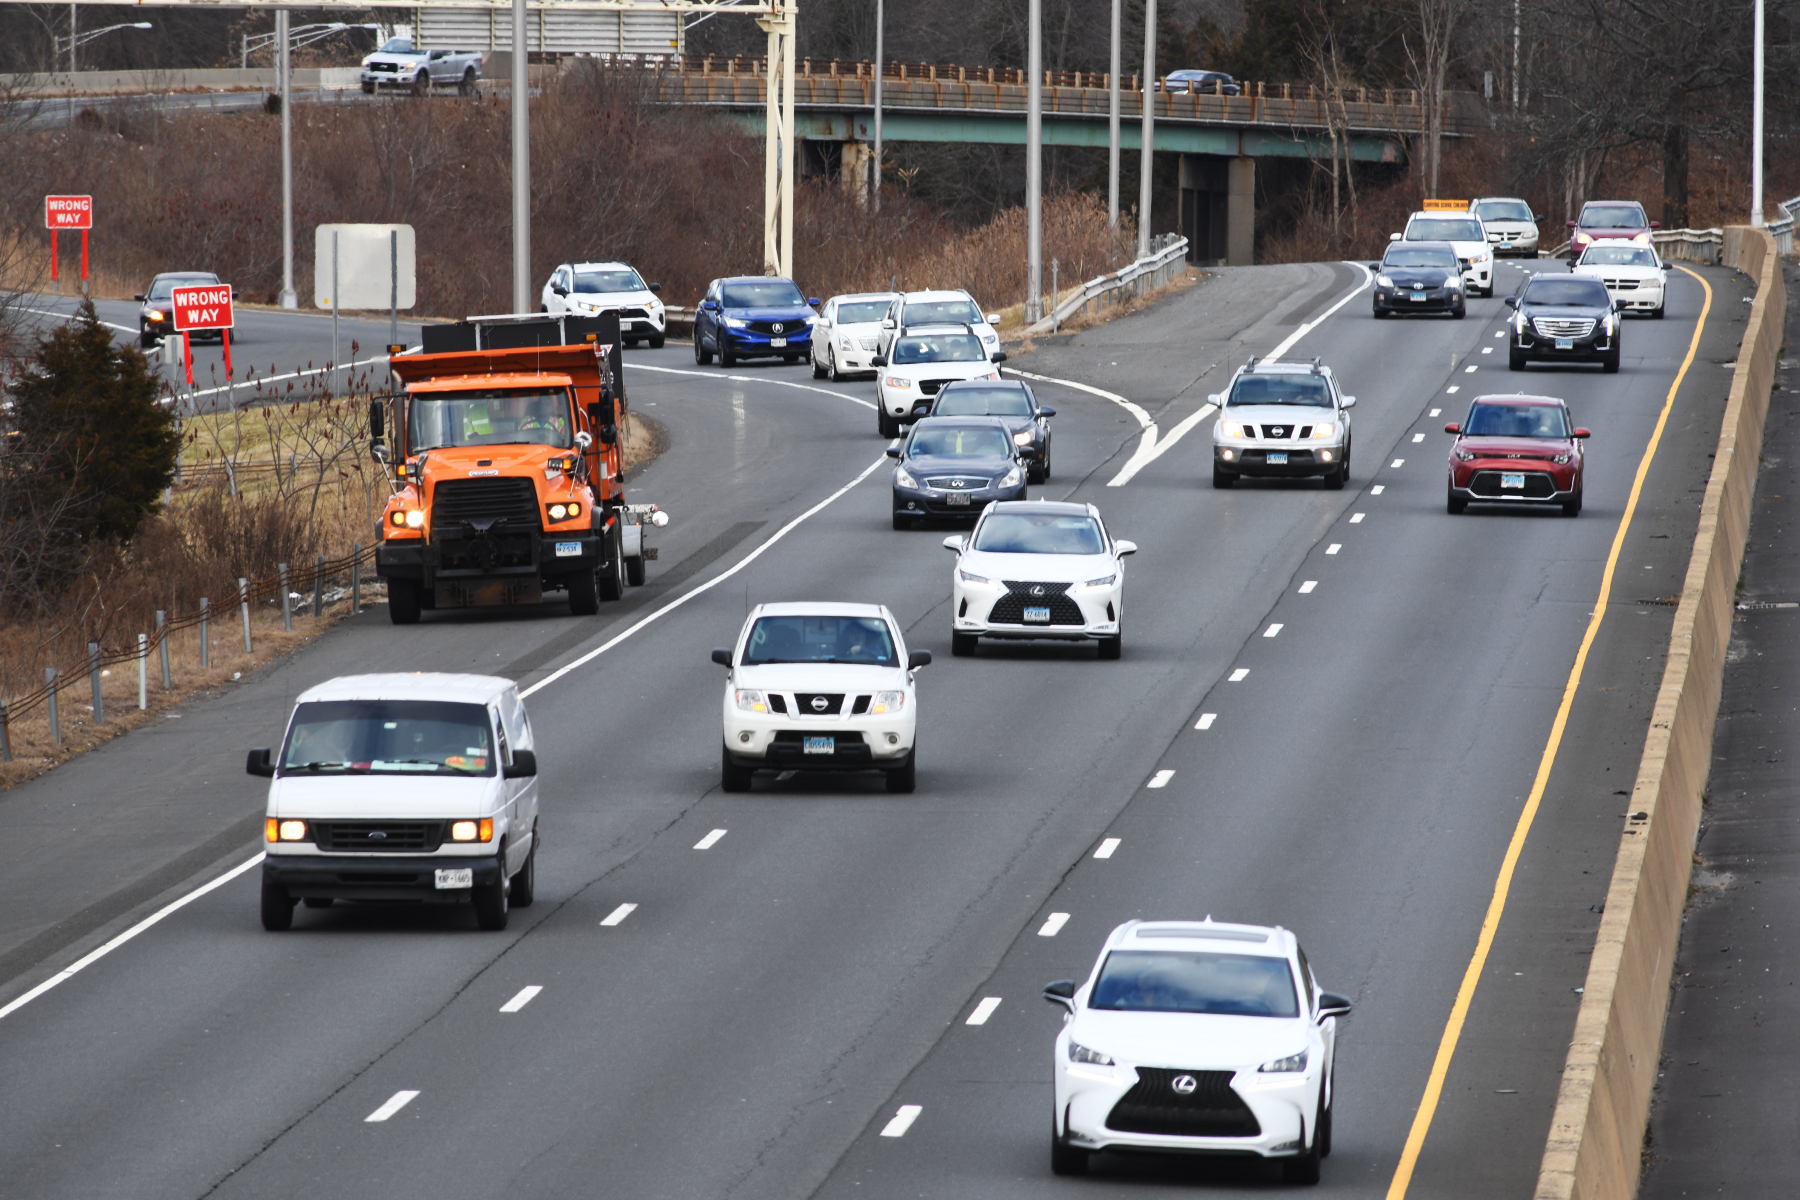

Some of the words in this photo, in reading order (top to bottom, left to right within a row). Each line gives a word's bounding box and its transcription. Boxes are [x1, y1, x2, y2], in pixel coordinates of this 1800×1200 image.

[49, 200, 89, 211] WRONG
[57, 213, 81, 223] WAY
[175, 290, 229, 307] WRONG
[187, 308, 220, 324] WAY
